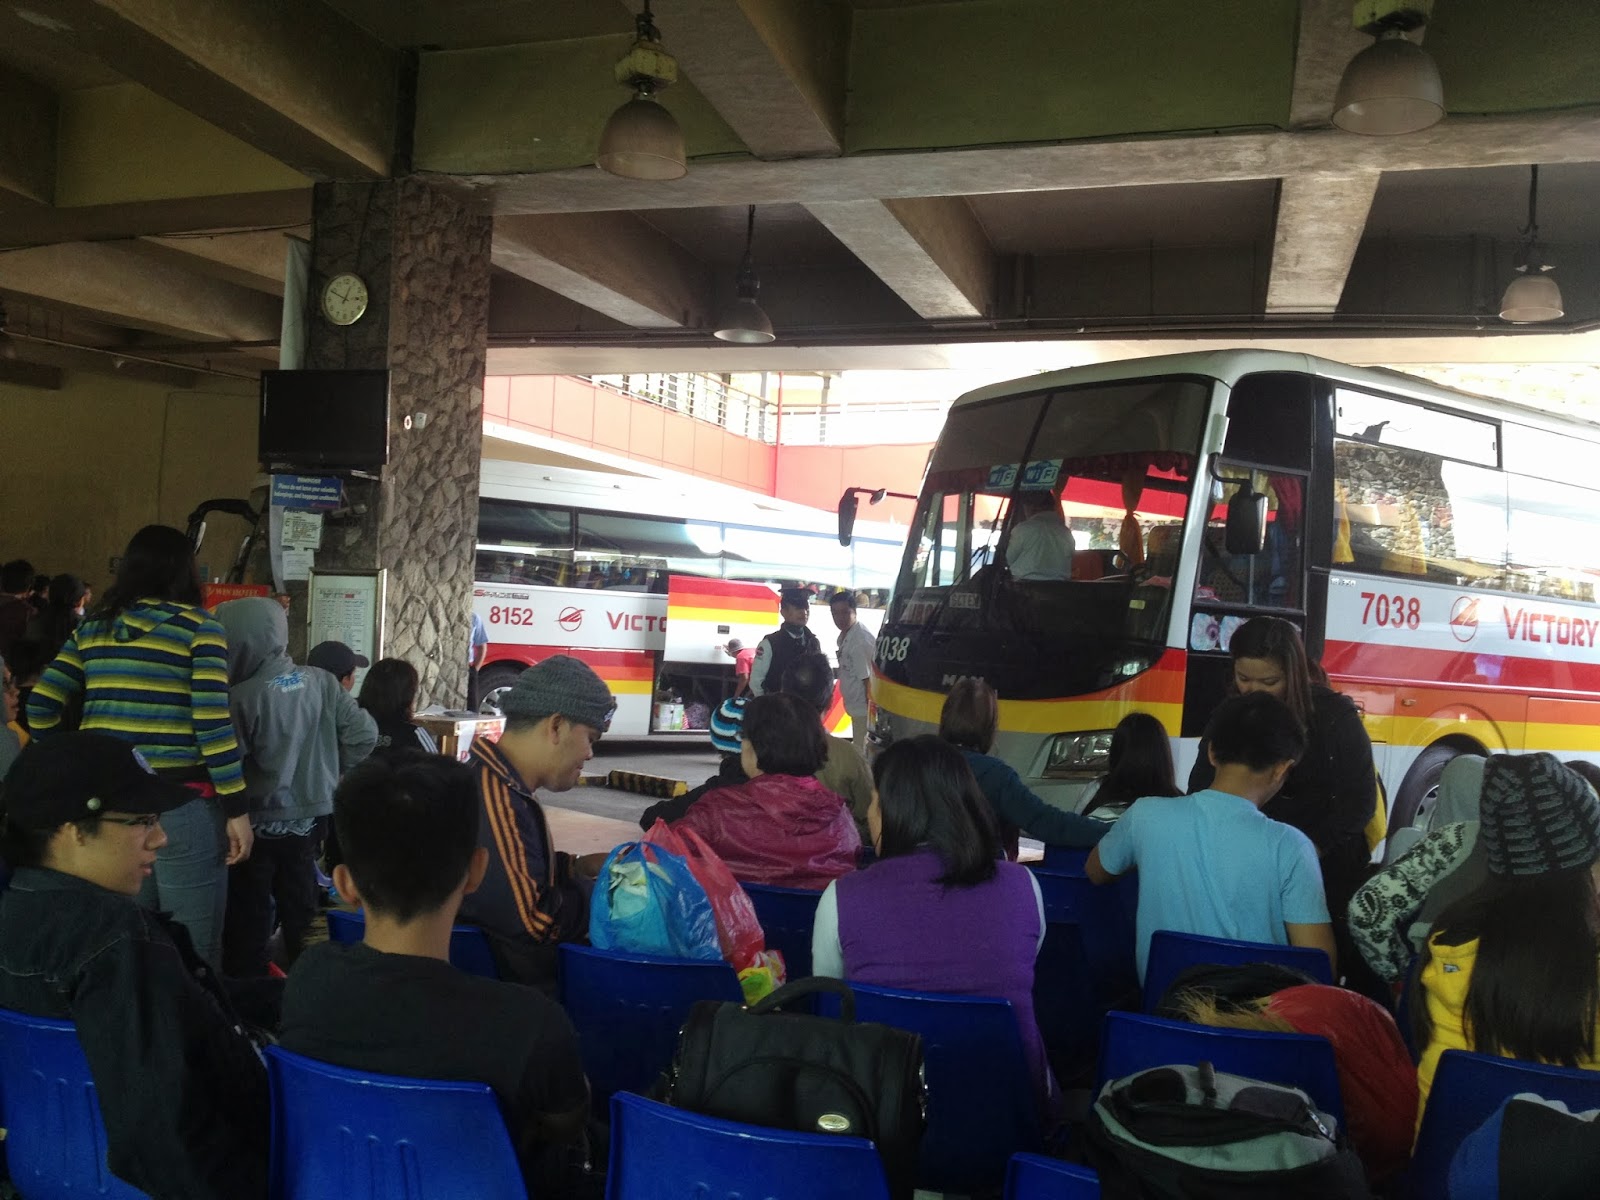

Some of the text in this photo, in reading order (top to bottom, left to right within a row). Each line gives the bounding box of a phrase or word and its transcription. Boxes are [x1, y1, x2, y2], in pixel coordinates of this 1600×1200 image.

[489, 606, 534, 626] 8152
[1361, 591, 1421, 630] 7038
[1503, 604, 1599, 648] VICTORY
